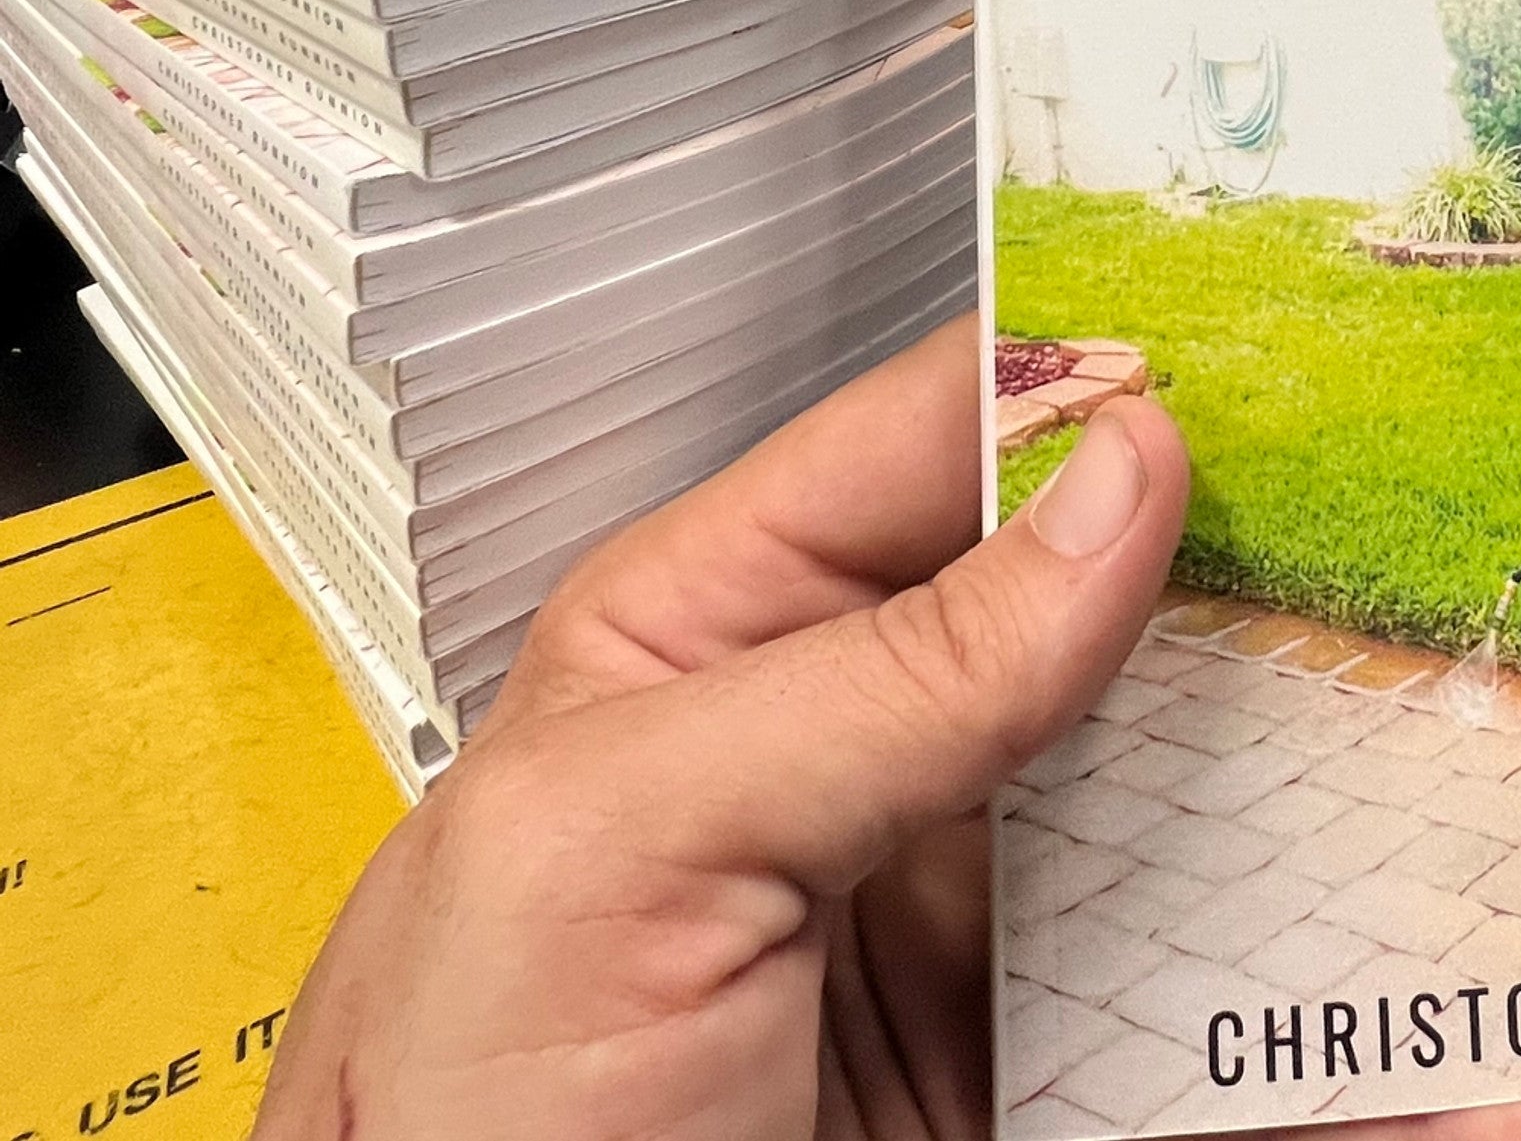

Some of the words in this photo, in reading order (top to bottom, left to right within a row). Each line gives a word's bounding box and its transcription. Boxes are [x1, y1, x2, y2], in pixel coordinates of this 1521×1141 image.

[192, 16, 293, 83] CHRISTOPHER
[305, 81, 382, 136] RUNNION
[279, 31, 355, 83] RUNNION
[158, 61, 243, 132] CHRISTOPHER
[252, 130, 318, 188] RUNNION
[79, 1049, 201, 1135] USE
[235, 1008, 286, 1063] IT
